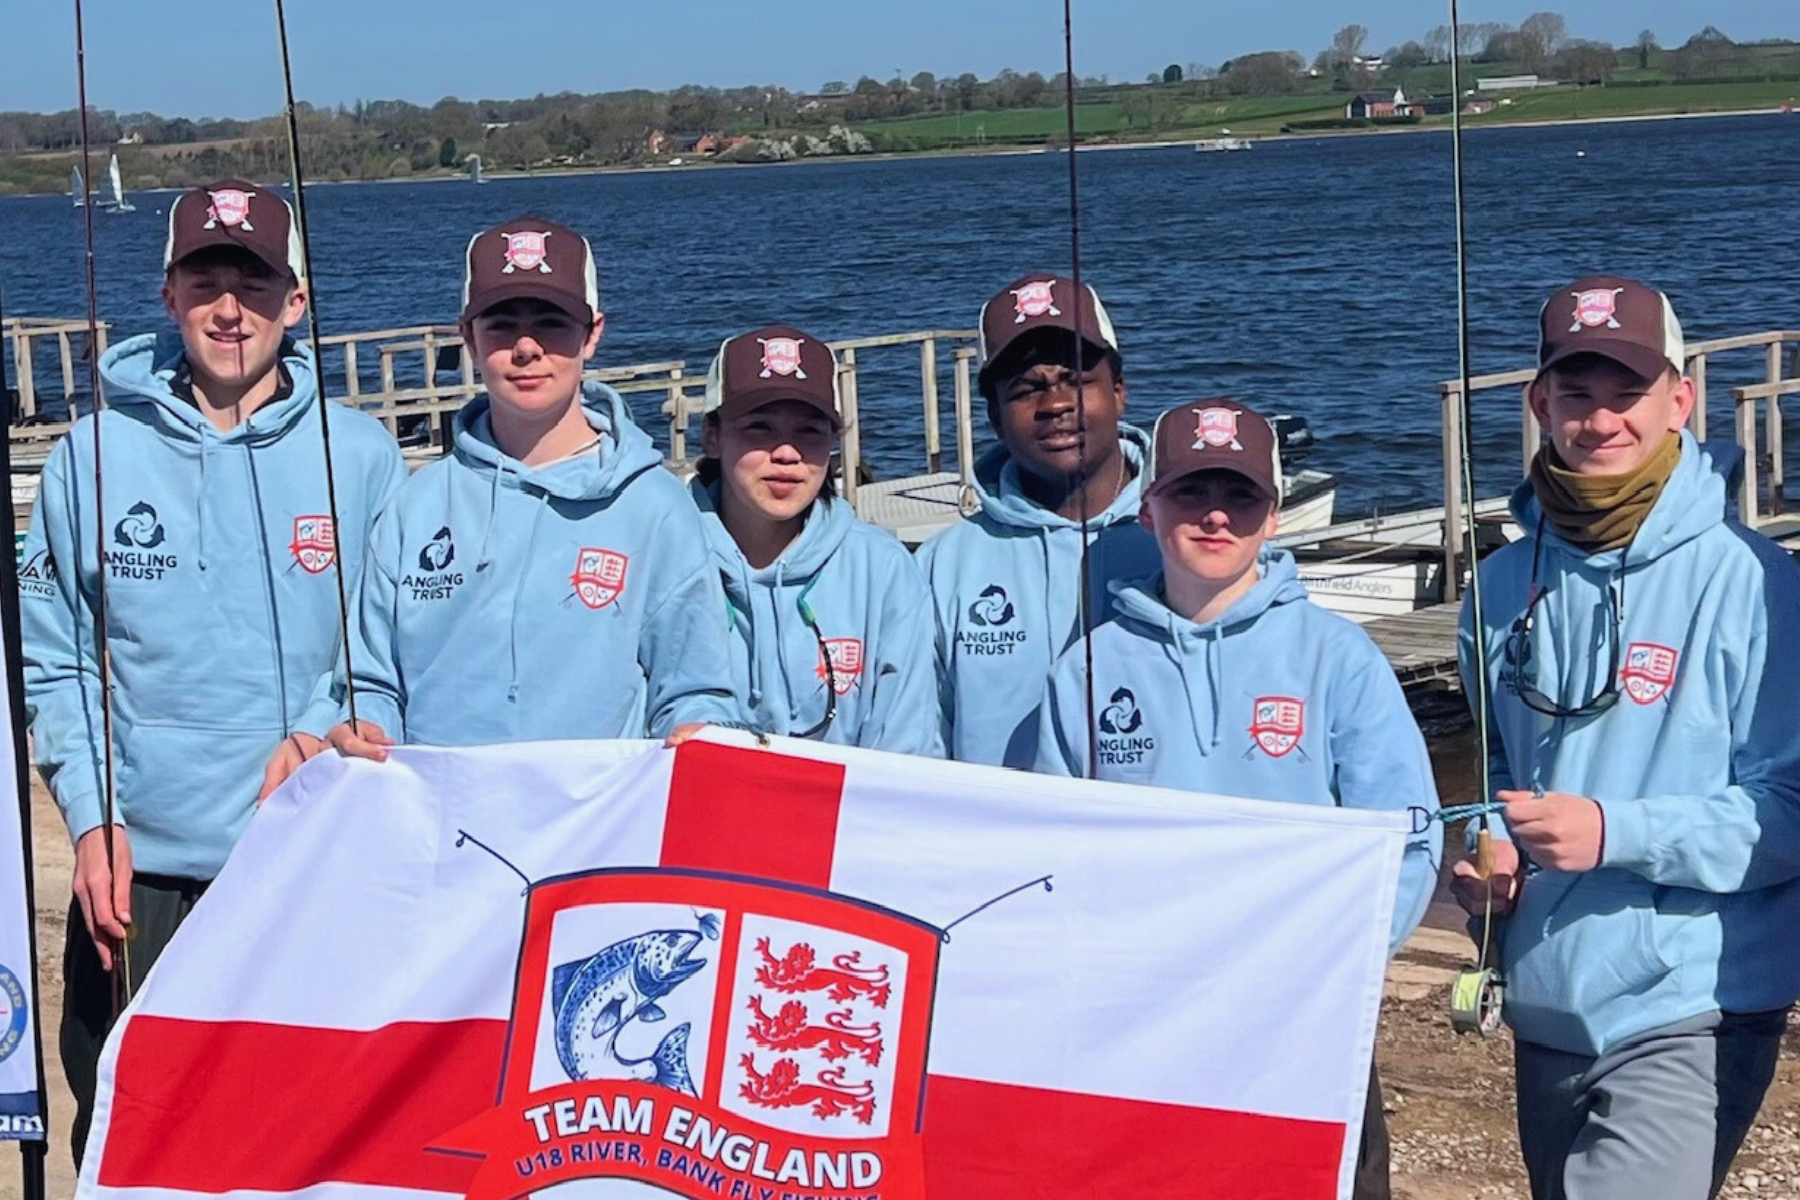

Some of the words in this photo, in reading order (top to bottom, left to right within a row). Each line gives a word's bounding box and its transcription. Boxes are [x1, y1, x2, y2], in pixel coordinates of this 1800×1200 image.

[103, 551, 177, 568] ANGLING
[112, 565, 165, 580] TRUST
[412, 586, 453, 600] TRUST
[1353, 578, 1393, 595] Anglers
[956, 630, 1026, 643] ANGLING
[964, 643, 1015, 656] TRUST
[1097, 737, 1154, 751] NGLING
[1099, 751, 1143, 765] TRUST
[524, 1095, 655, 1143] TEAM
[662, 1105, 883, 1190] ENGLAND
[516, 1147, 563, 1176] U18
[570, 1141, 648, 1167] RIVER,
[657, 1149, 727, 1194] BANK
[730, 1178, 775, 1200] FLY
